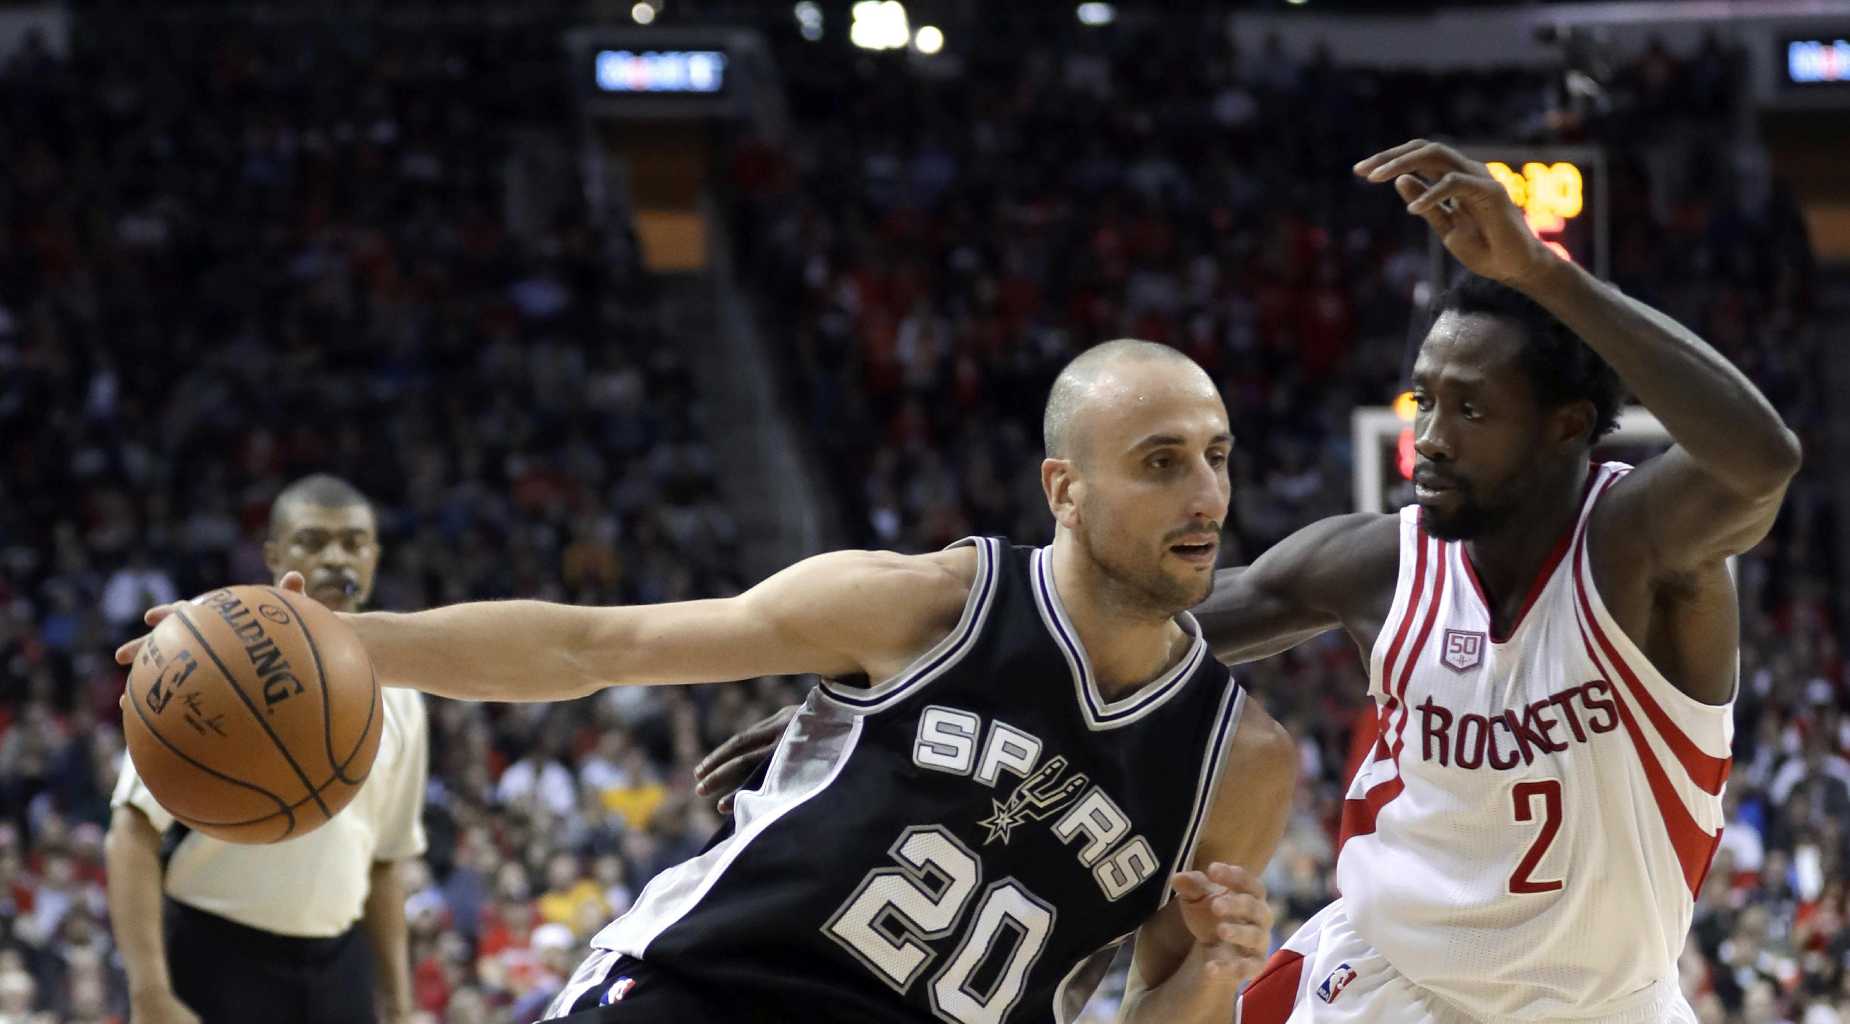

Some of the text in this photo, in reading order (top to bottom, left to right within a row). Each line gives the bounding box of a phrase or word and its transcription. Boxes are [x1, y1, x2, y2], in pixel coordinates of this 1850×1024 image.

[201, 588, 304, 706] PALDING
[1449, 634, 1478, 655] 50
[1415, 679, 1620, 771] ROCKETS
[912, 704, 1160, 902] SPURS
[1508, 778, 1564, 894] 2
